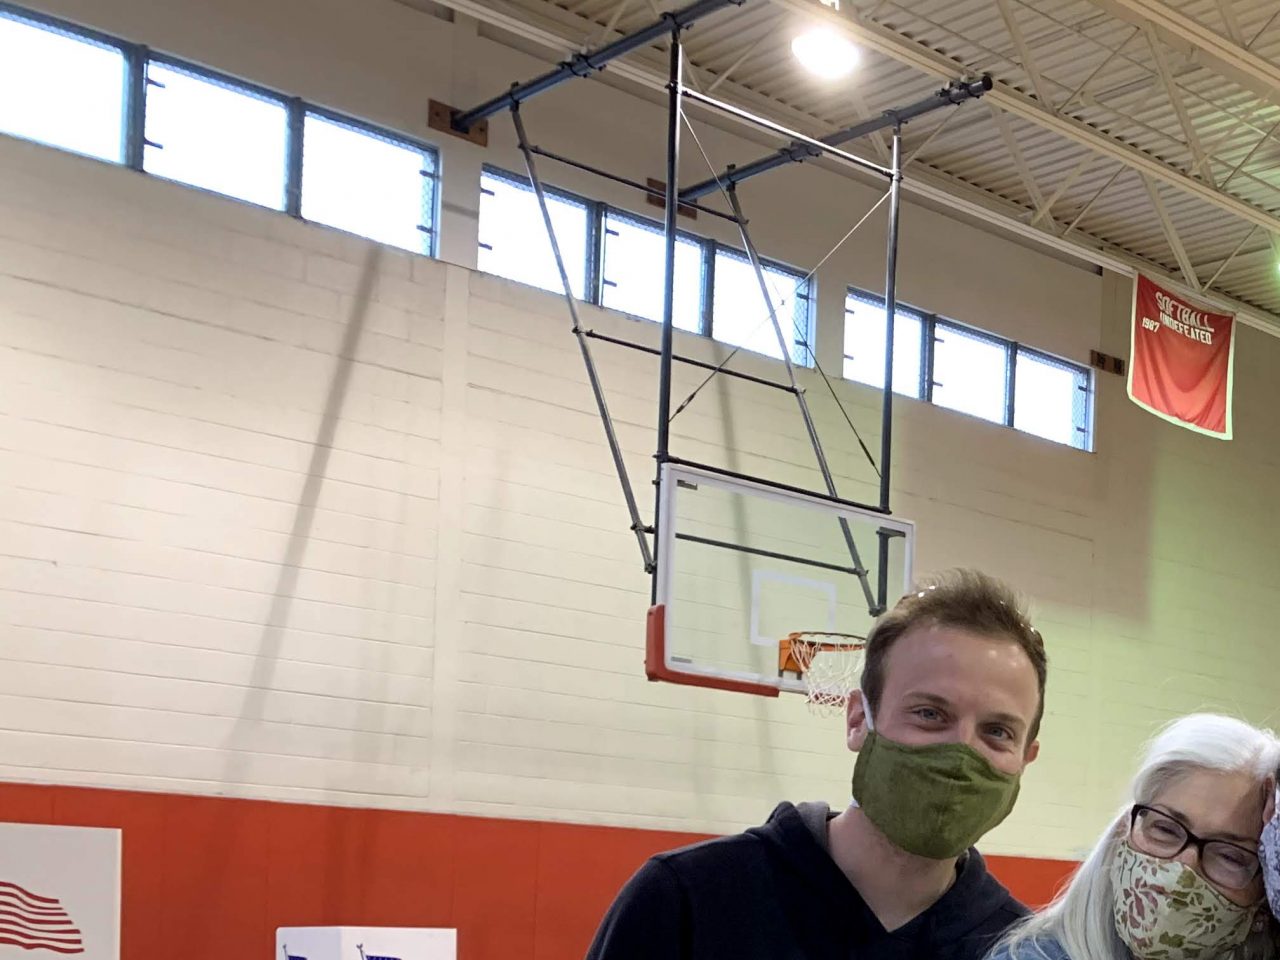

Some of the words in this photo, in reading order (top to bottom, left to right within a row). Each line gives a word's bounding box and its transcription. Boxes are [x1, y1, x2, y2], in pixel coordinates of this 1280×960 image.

[1142, 316, 1160, 333] 1987
[1155, 291, 1215, 333] SOFTBALL
[1160, 311, 1212, 345] UNDEFEATED
